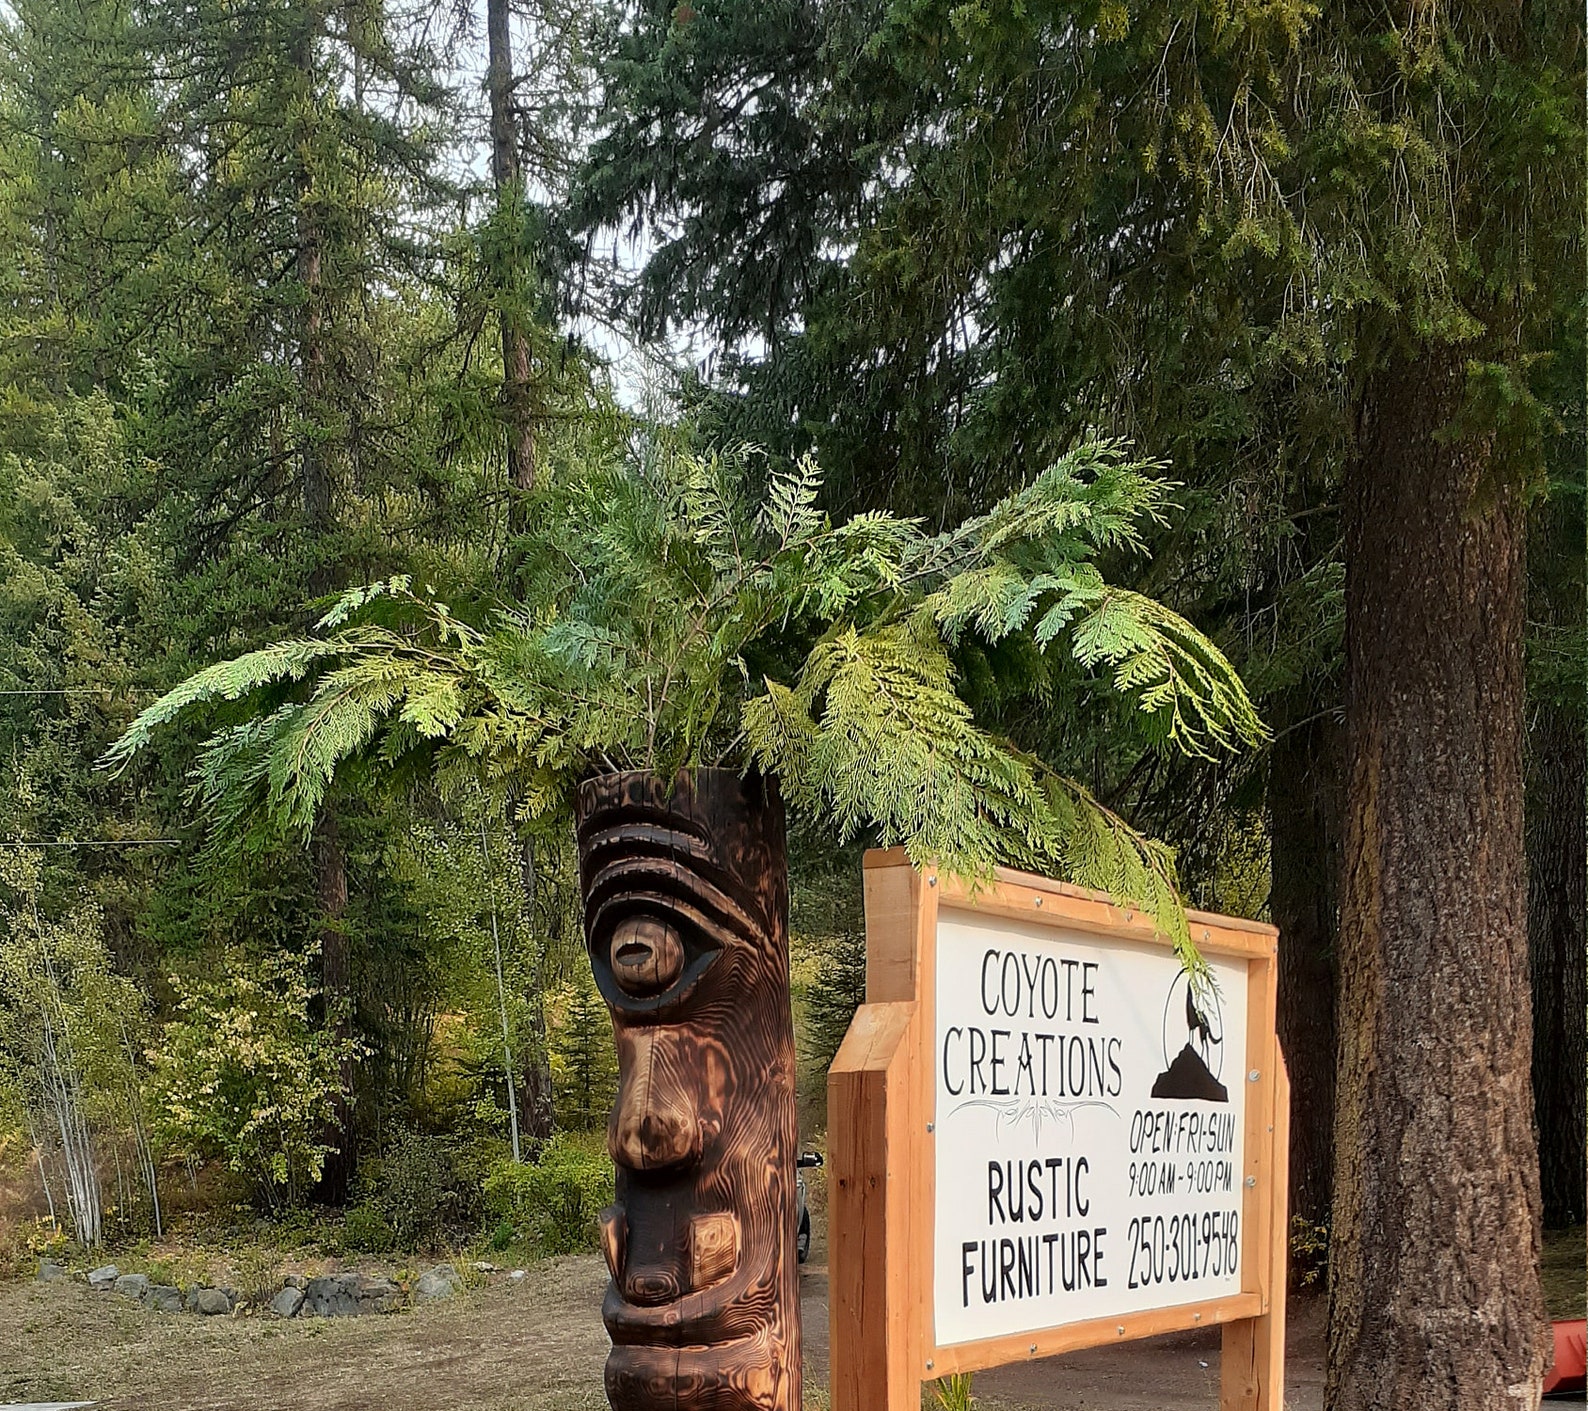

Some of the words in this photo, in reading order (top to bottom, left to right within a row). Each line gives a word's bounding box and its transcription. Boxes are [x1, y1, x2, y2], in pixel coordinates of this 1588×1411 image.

[981, 948, 1100, 1024] COYOTE
[943, 1026, 1122, 1097] CREATIONS
[988, 1156, 1090, 1226] RUSTIC
[962, 1228, 1108, 1308] FURNITURE
[1127, 1210, 1239, 1290] 250-301-9548
